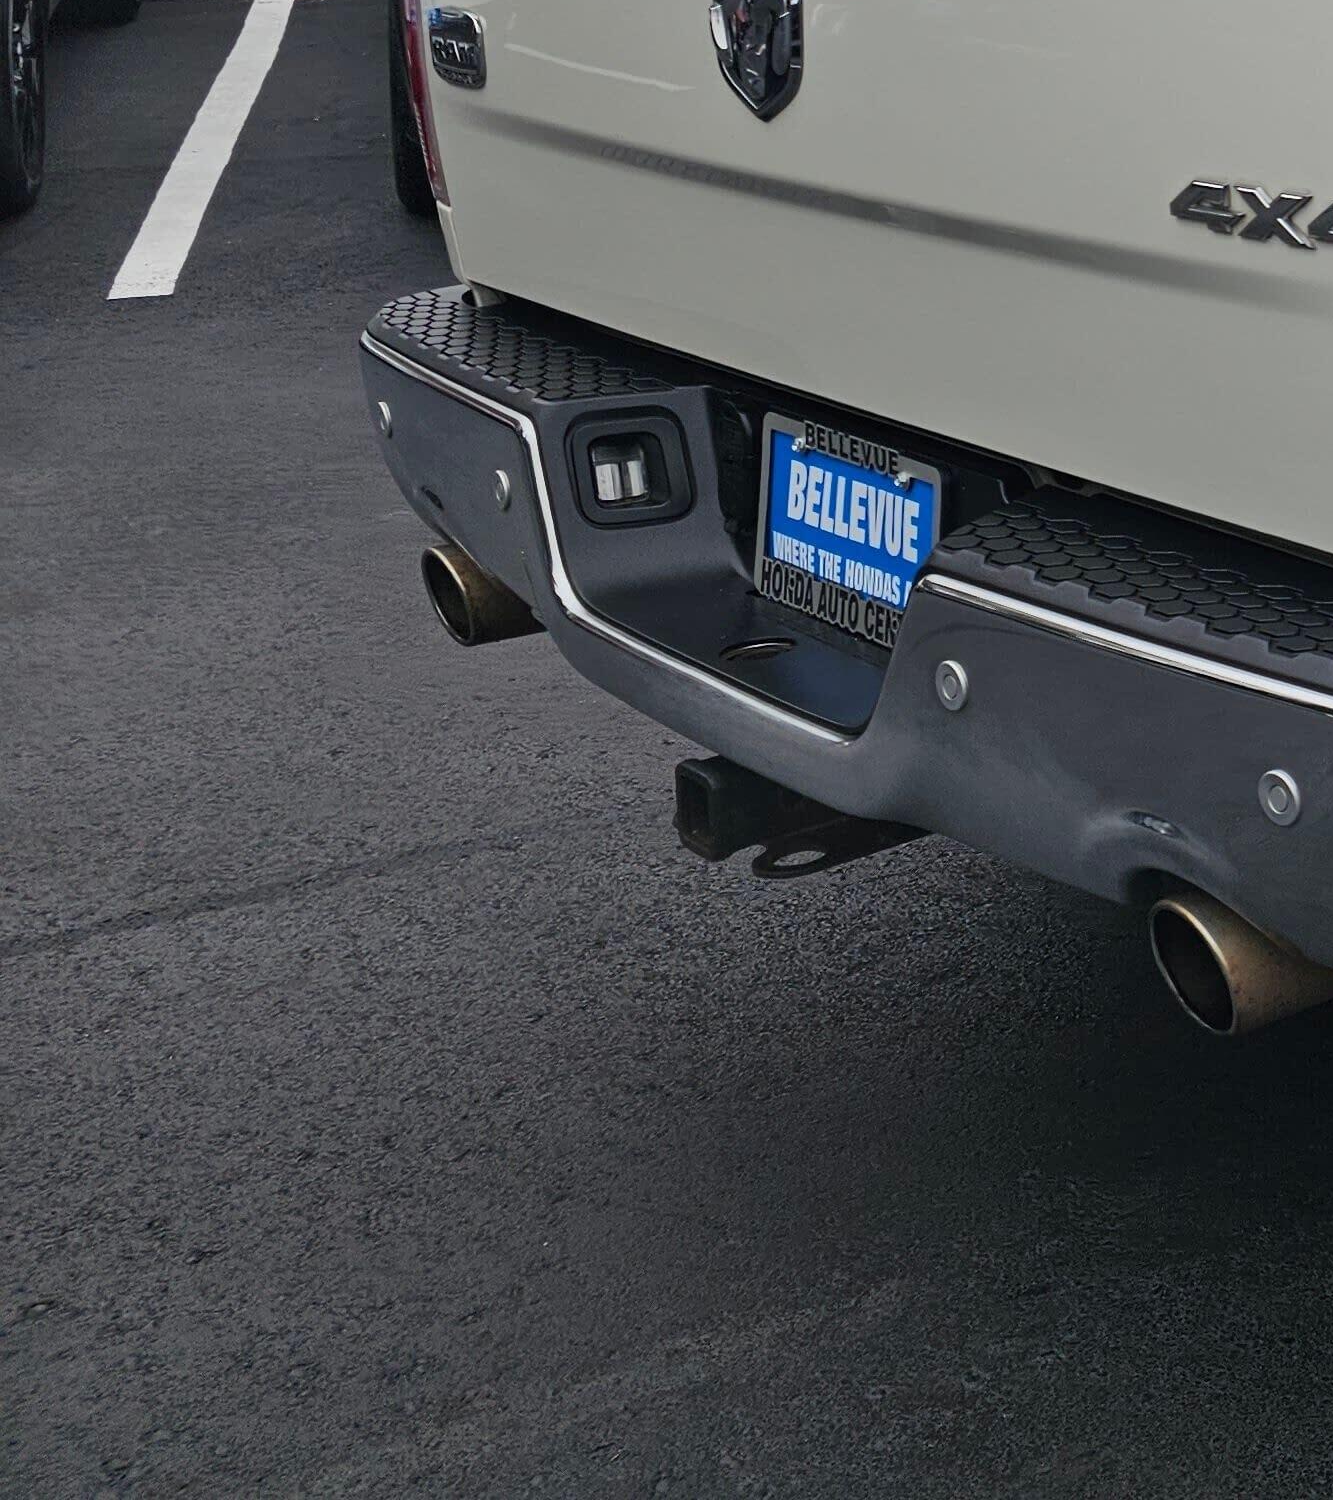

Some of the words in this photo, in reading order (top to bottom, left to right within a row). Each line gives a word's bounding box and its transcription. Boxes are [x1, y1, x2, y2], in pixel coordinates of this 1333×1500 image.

[432, 36, 481, 68] RAM
[804, 421, 900, 476] BELLEVUE
[786, 460, 920, 563] BELLEVUE
[761, 556, 814, 612] HONDA
[817, 582, 859, 632] AUTO
[864, 601, 902, 647] CEN
[772, 531, 815, 573] WHERE
[817, 549, 842, 582] THE
[844, 558, 902, 606] HONDAS
